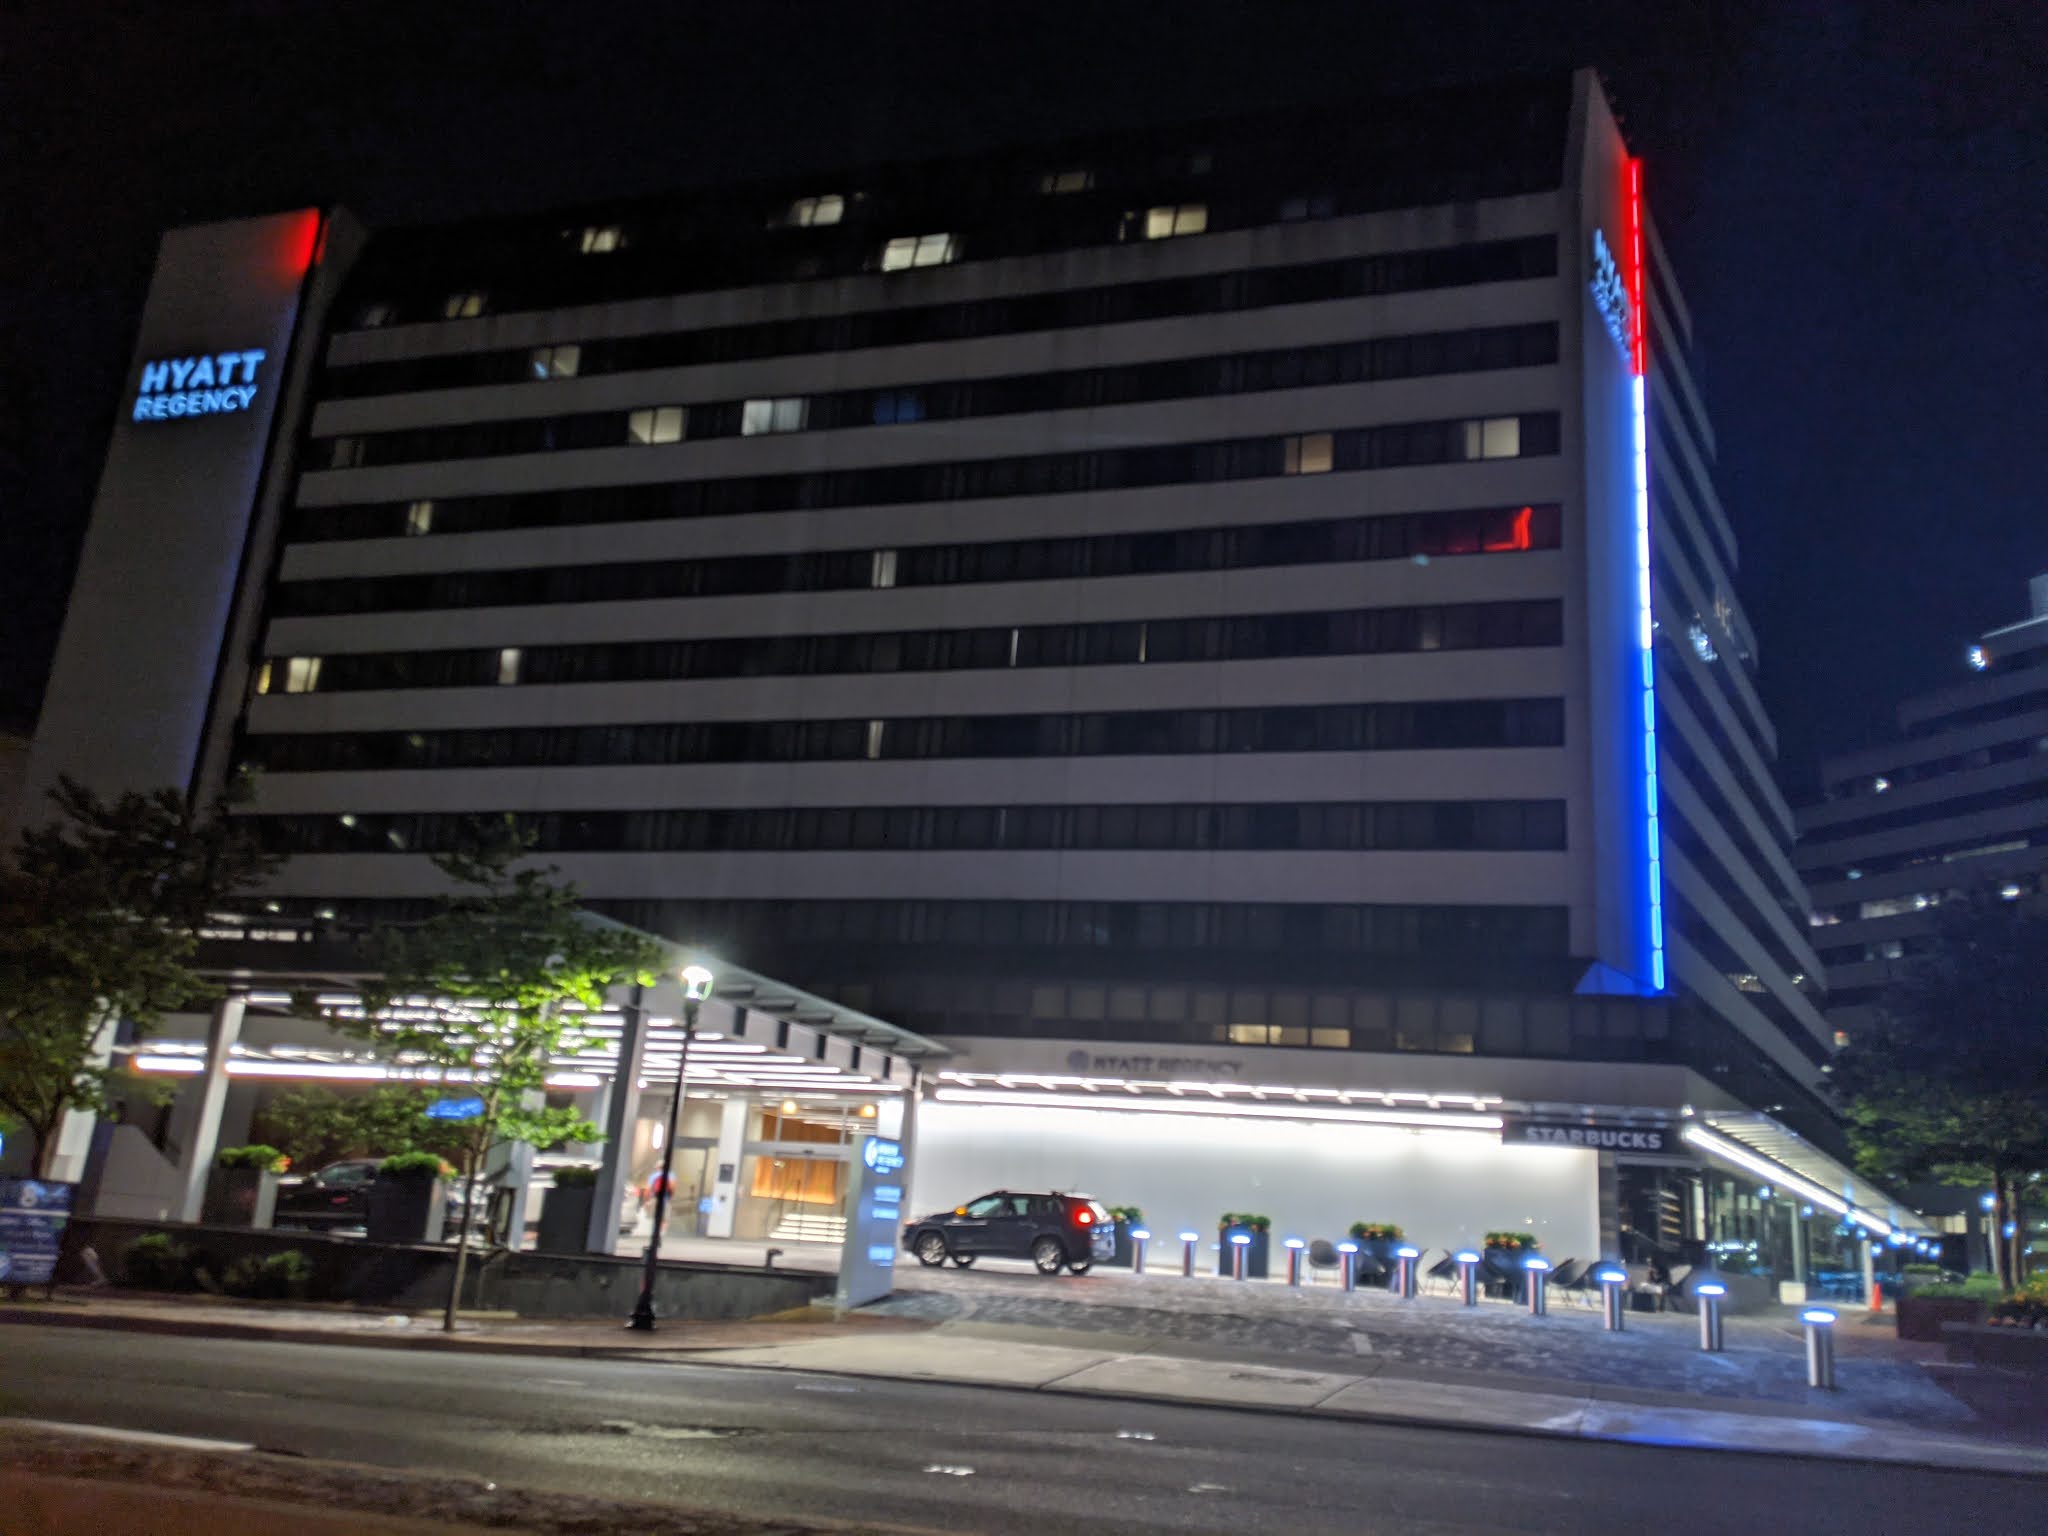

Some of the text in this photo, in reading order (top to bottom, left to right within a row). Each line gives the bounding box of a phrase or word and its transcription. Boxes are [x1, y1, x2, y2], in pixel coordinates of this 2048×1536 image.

[140, 349, 266, 393] HYATT
[132, 384, 258, 423] REGENCY
[1094, 1055, 1153, 1072] HYATT
[1525, 1126, 1663, 1149] STARBUCKS
